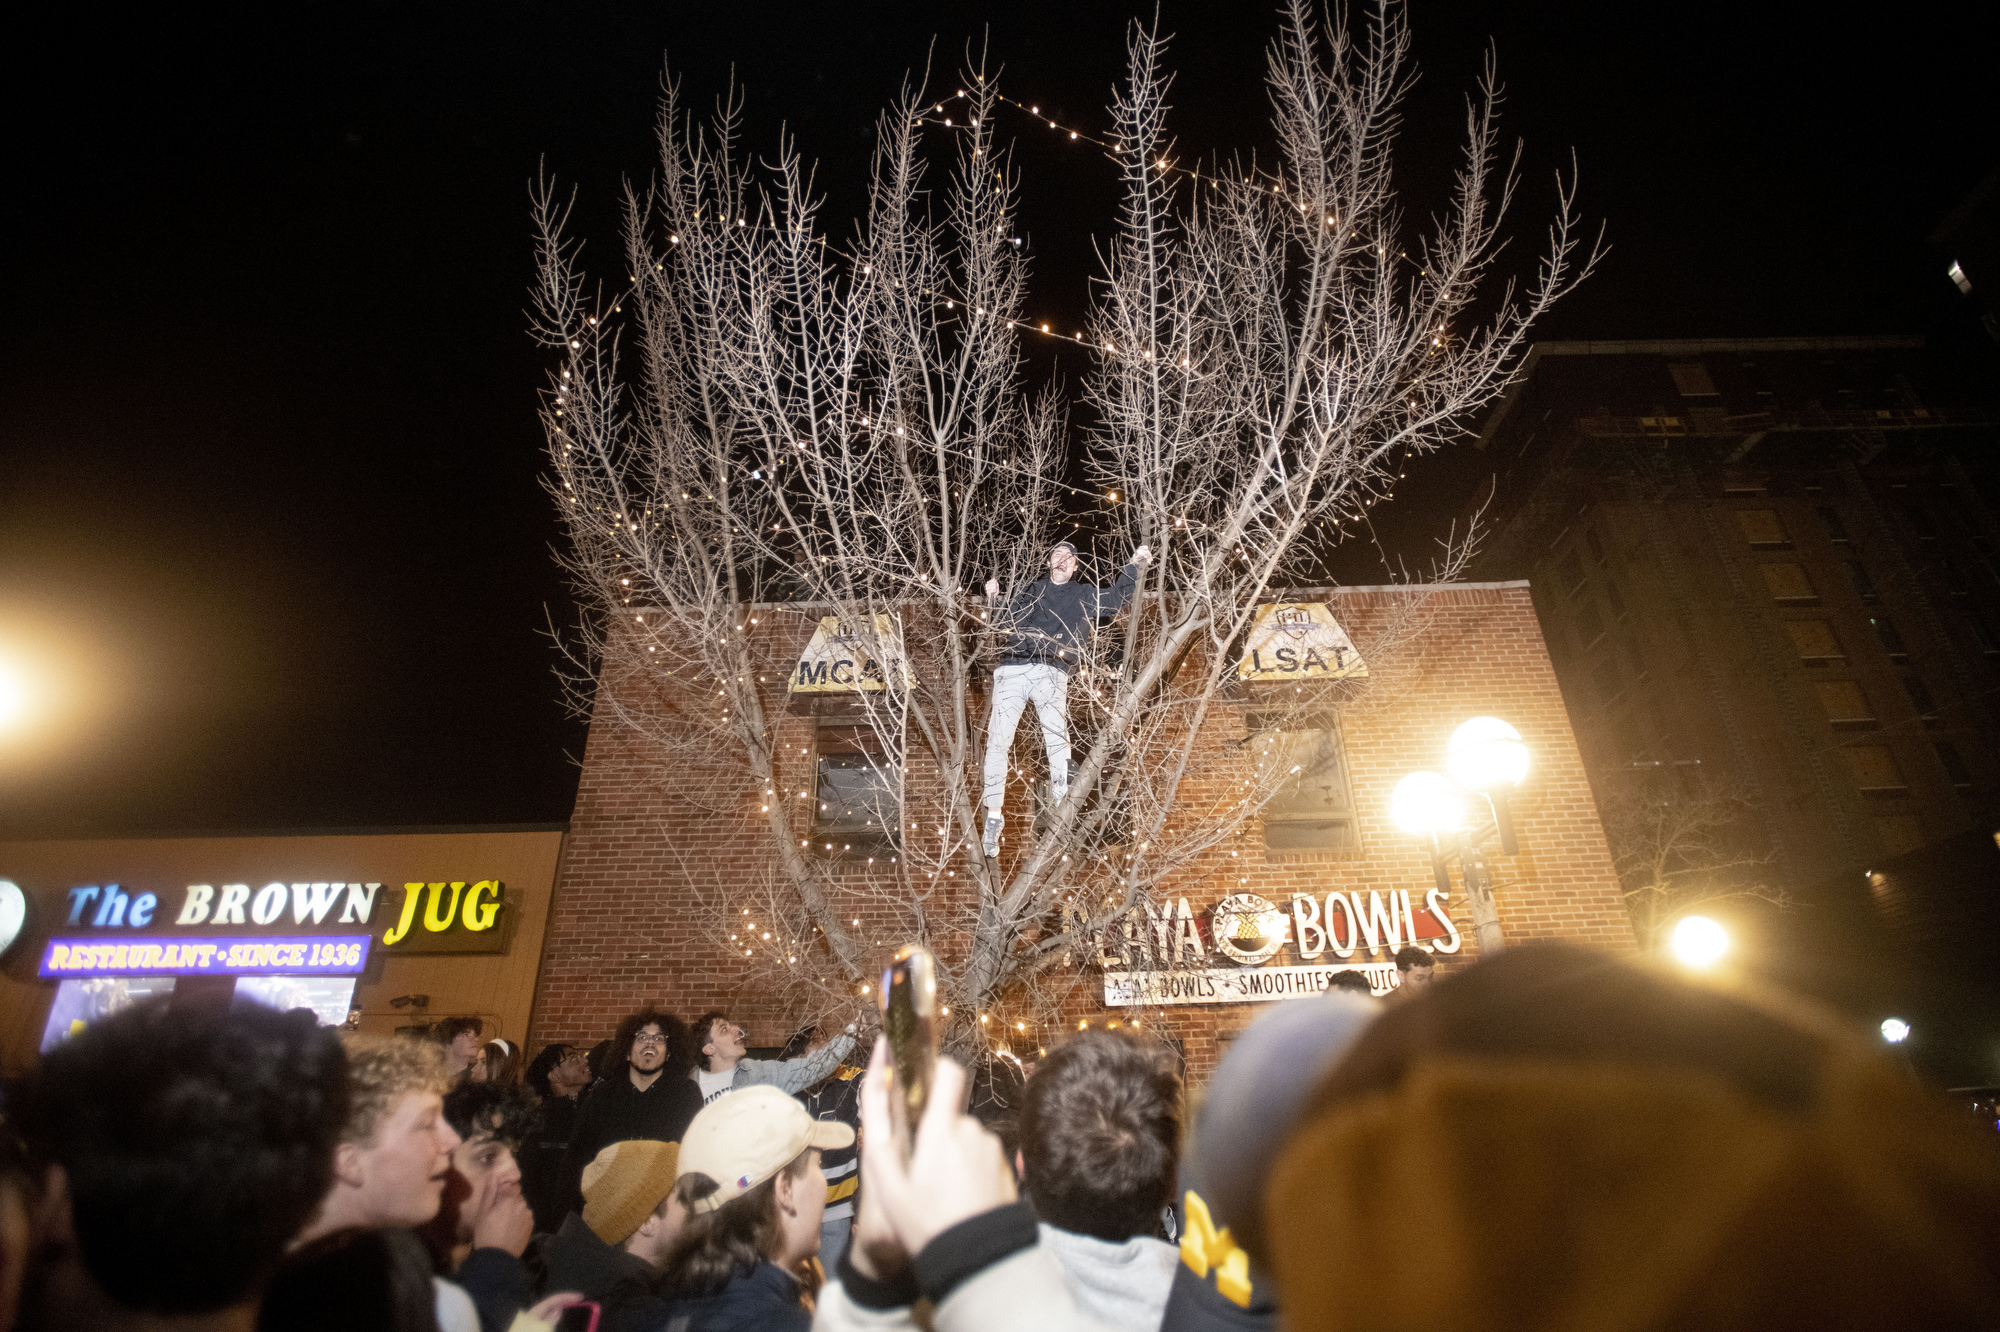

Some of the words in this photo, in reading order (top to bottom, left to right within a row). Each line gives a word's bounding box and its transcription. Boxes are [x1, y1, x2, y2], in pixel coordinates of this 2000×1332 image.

[1252, 646, 1348, 673] LSAT
[63, 883, 157, 927] The
[175, 882, 381, 925] BROWN
[382, 880, 500, 946] JUG
[1292, 888, 1461, 960] BOWLS
[48, 944, 217, 969] RESTAURANT
[226, 943, 307, 967] SINCE
[308, 943, 361, 966] 1936
[1160, 976, 1215, 998] BOWLS
[1239, 971, 1331, 995] SMOOTHIES
[1360, 968, 1398, 990] UIC
